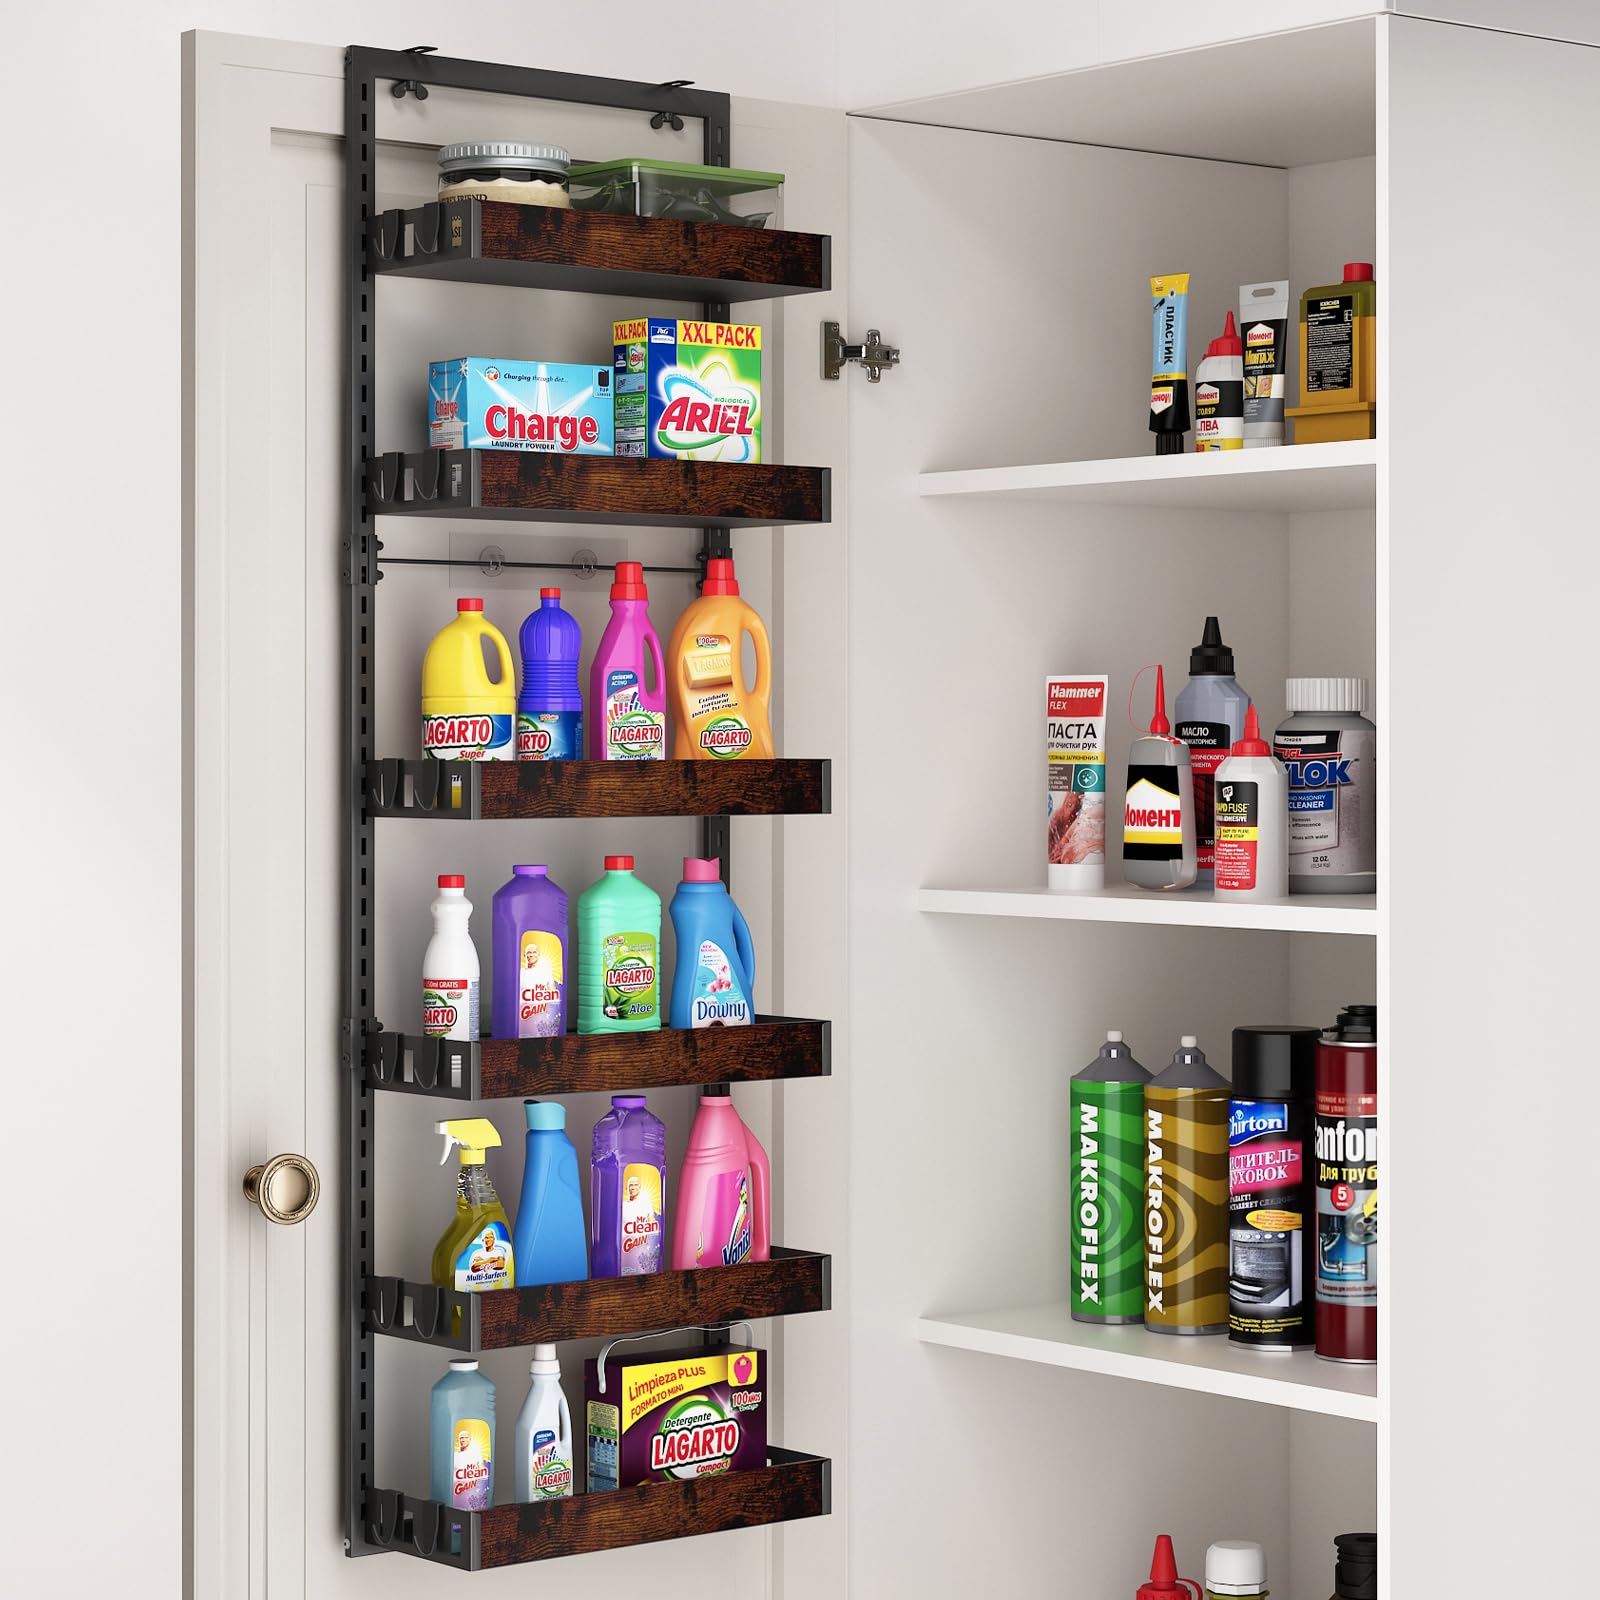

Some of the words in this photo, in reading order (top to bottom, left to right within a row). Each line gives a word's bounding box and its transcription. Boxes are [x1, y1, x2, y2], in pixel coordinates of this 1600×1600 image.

[614, 324, 628, 341] XXL
[629, 321, 647, 338] PACK
[682, 322, 713, 345] XXL
[716, 325, 756, 348] PACK
[1163, 306, 1175, 365] ПЛАСТИК
[503, 372, 532, 382] Charging
[714, 397, 750, 405] BIOLOGICAL
[434, 400, 458, 419] Charge
[659, 397, 753, 435] ARIEL
[485, 404, 599, 452] Charge
[1200, 420, 1219, 431] ПВА
[491, 440, 523, 449] LAUNDRY
[525, 442, 555, 450] POWDER
[698, 693, 729, 704] Cuidado
[1050, 684, 1102, 699] Hammer
[692, 708, 710, 719] para
[721, 702, 739, 710] ropa
[701, 697, 730, 709] natural
[1049, 701, 1067, 710] FLEX
[612, 726, 660, 743] LAGARTO
[702, 730, 750, 746] LAGARTO
[1048, 723, 1098, 739] ПАСТА
[1181, 727, 1210, 737] МАСЛО
[459, 750, 486, 759] Super
[1283, 748, 1302, 758] UGL
[1228, 802, 1248, 813] FUSE
[1288, 801, 1325, 809] CLEANER
[609, 968, 653, 985] LAGARTO
[521, 988, 559, 1002] Clean
[521, 1003, 547, 1020] GAIN
[629, 1003, 653, 1014] Aloe
[696, 1000, 746, 1021] Downy
[1320, 1162, 1339, 1182] Для
[1337, 1186, 1347, 1201] 5
[1080, 1102, 1099, 1305] MAKROFLEX
[1148, 1108, 1164, 1313] MAKROFLEX
[623, 1220, 659, 1234] Clean
[623, 1234, 648, 1253] GAIN
[722, 1226, 750, 1265] Vanis
[465, 1270, 508, 1282] Multi-Surfaces
[628, 1373, 677, 1401] Limpieza
[678, 1365, 706, 1381] PLUS
[630, 1390, 667, 1420] FORMATO
[667, 1384, 684, 1398] MINI
[664, 1412, 712, 1429] Detergente
[654, 1423, 738, 1466] LAGARTO
[455, 1467, 488, 1480] Clean
[696, 1459, 729, 1474] Compact
[537, 1471, 570, 1487] LAGARTO
[454, 1479, 478, 1496] GAIN
